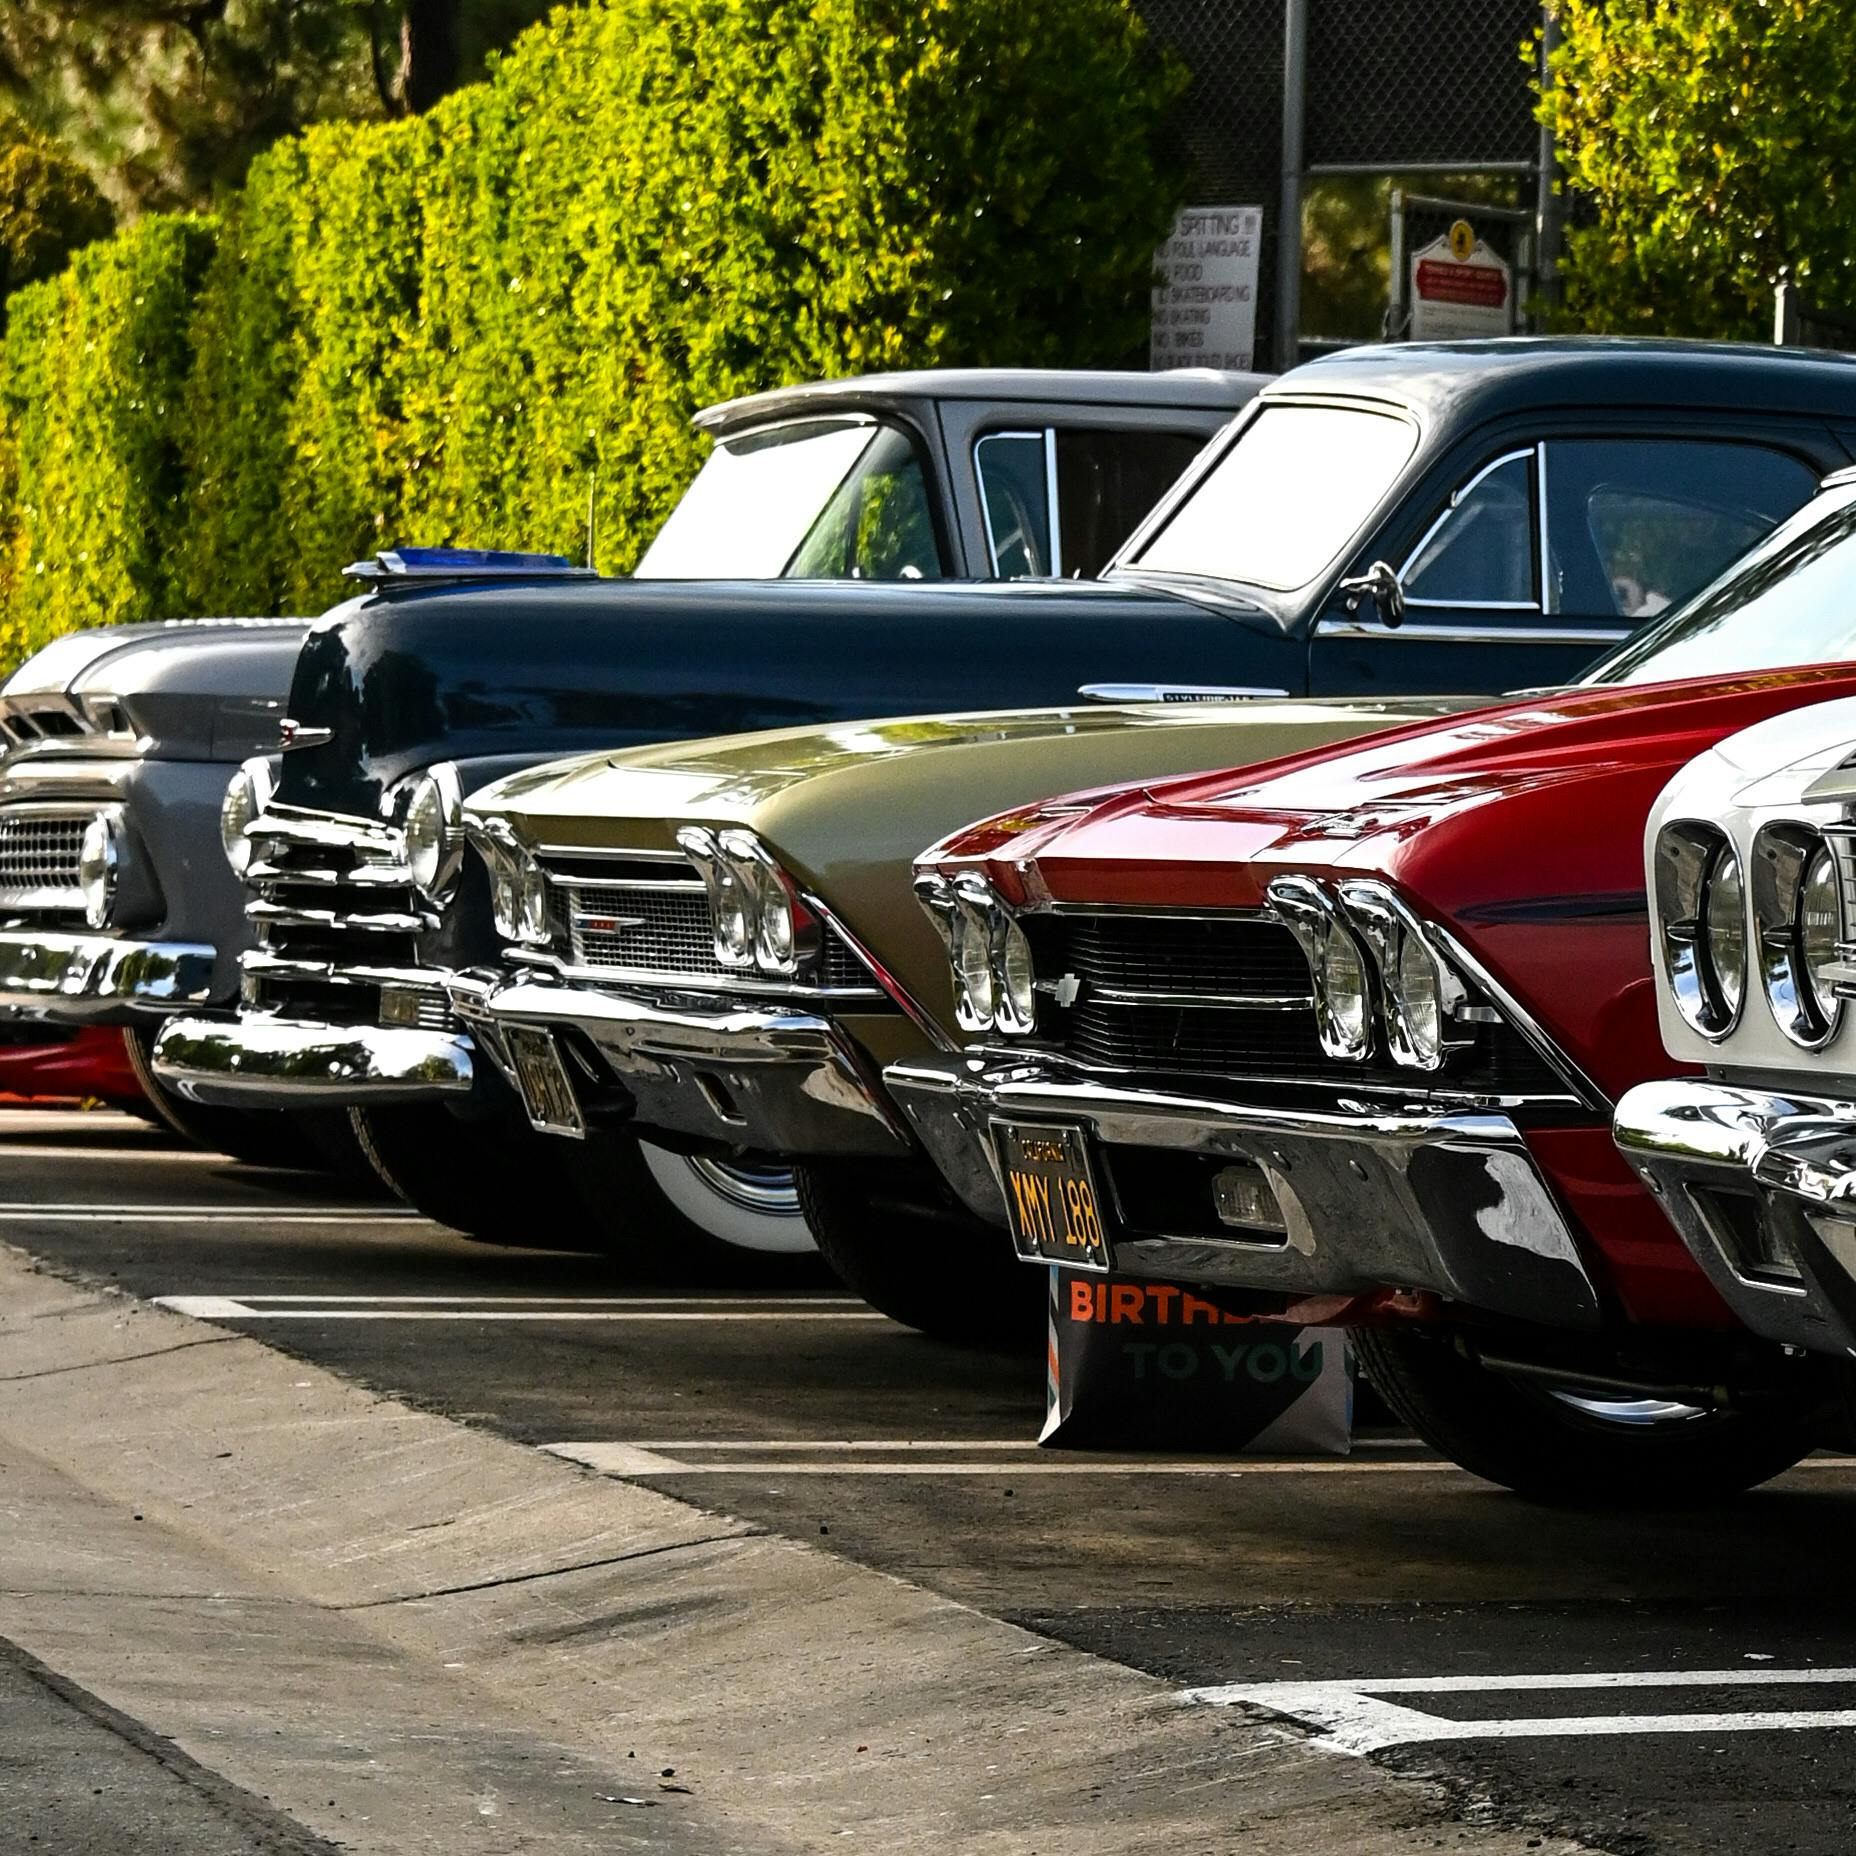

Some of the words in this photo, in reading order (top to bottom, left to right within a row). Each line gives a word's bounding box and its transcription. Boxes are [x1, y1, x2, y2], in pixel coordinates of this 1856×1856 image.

[1181, 214, 1240, 237] SPITTING
[1169, 285, 1250, 304] SKATEBOARDING
[1010, 1170, 1056, 1243] XMY
[1058, 1176, 1101, 1248] 188
[1070, 1280, 1253, 1325] BIRTH
[1122, 1342, 1200, 1380] TO
[1209, 1341, 1324, 1384] YOU
